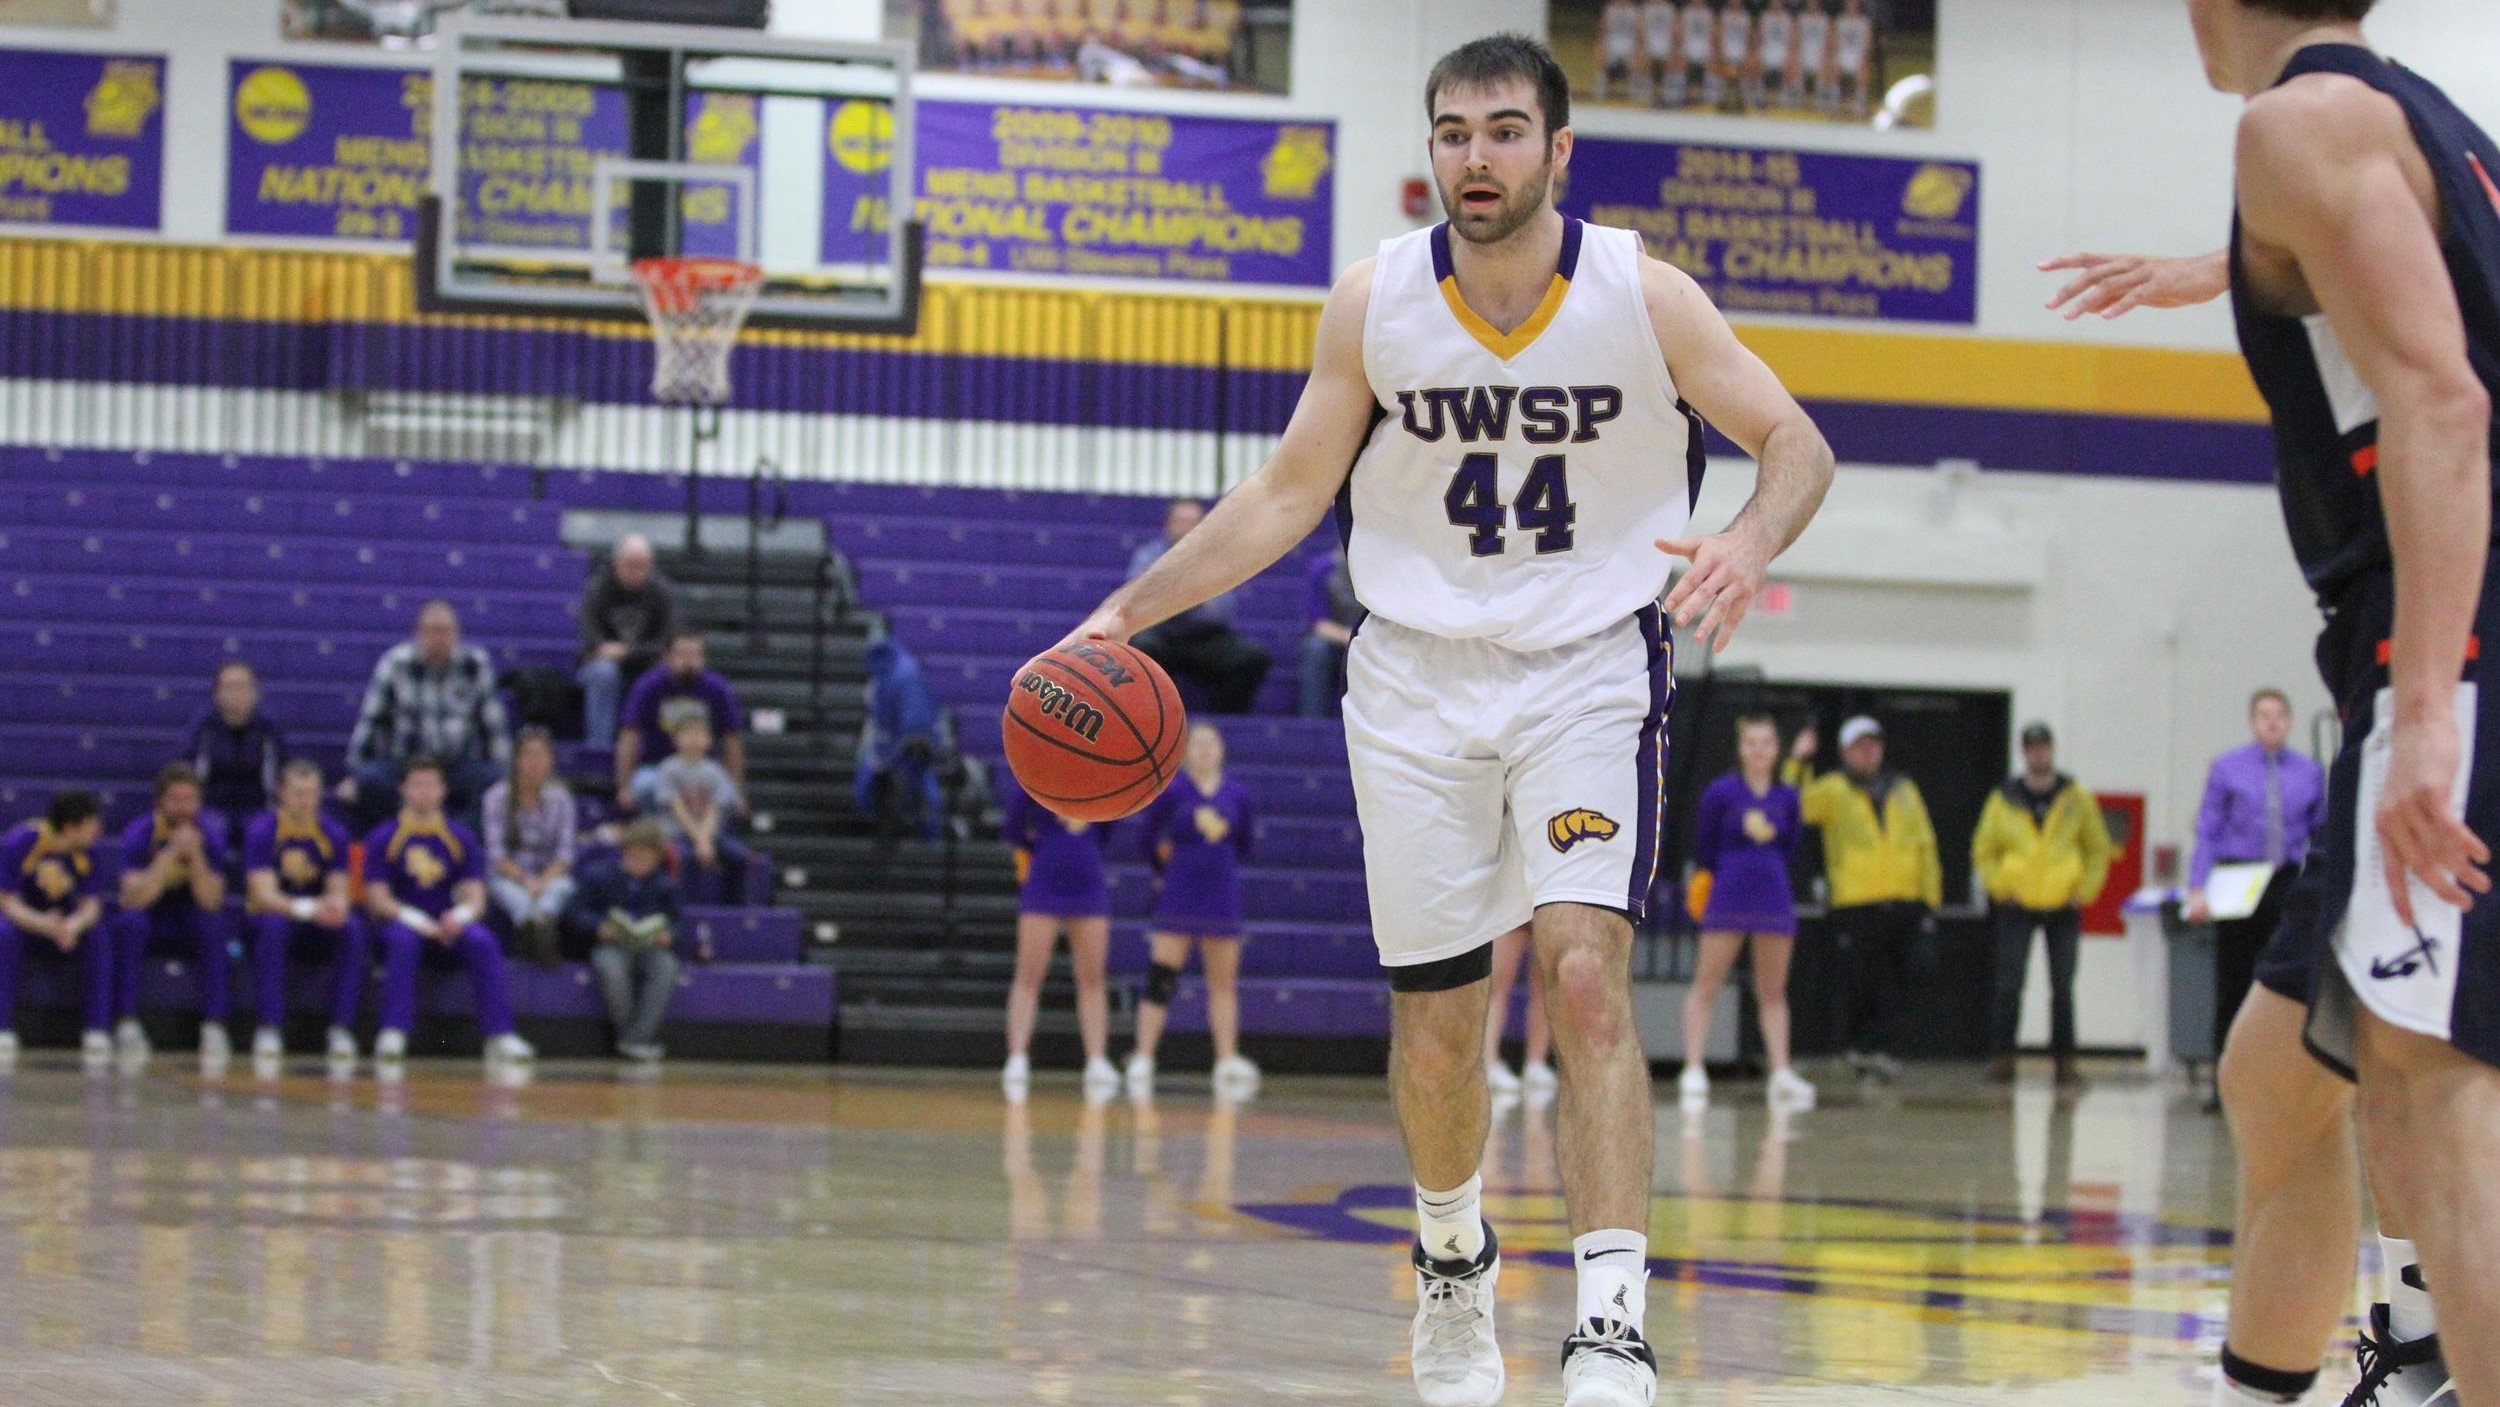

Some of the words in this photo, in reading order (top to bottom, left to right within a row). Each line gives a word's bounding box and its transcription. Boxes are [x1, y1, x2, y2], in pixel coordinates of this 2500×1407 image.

[993, 108, 1173, 148] 2009-2010
[1001, 139, 1128, 171] DIVISION
[258, 165, 432, 208] NATION
[926, 167, 1017, 199] MENS
[1023, 173, 1231, 213] BASKETBALL
[1063, 208, 1303, 257] CHAMPIONS
[1685, 209, 1874, 254] BASKETBALL
[1723, 243, 1951, 294] CHAMPIONS
[1396, 385, 1623, 444] UWSP
[1444, 453, 1576, 557] 44
[1018, 670, 1105, 744] Wilson
